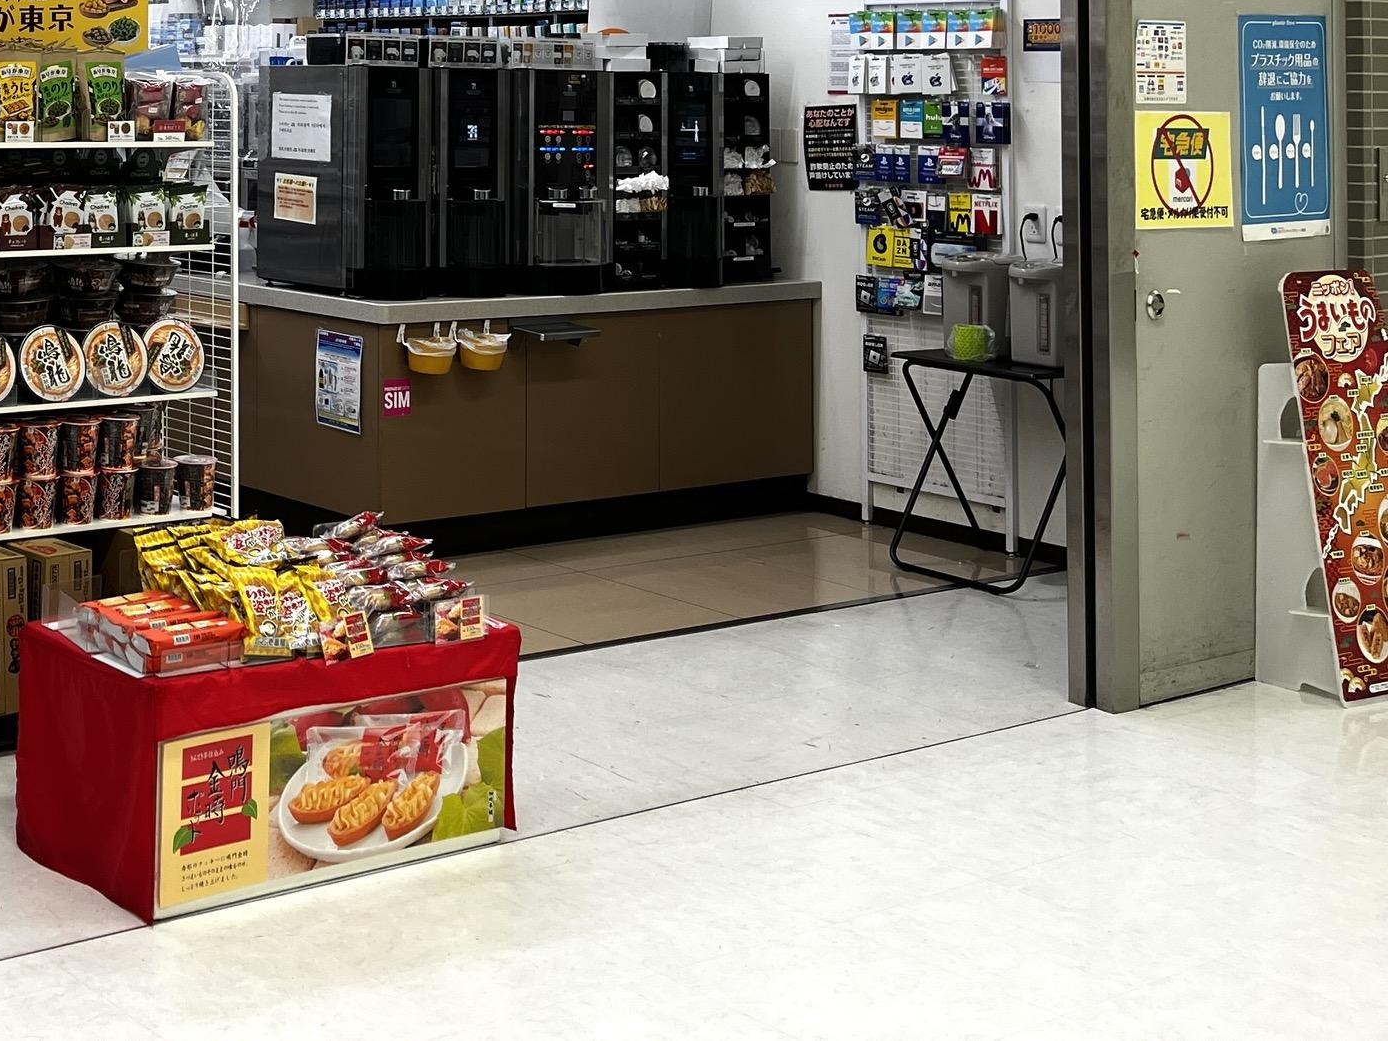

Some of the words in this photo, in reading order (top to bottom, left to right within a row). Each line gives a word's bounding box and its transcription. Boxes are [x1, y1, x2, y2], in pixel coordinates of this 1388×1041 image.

[806, 108, 854, 119] あなたのことが
[808, 118, 851, 128] 心配なんです
[809, 171, 853, 180] 声掛けしていま
[1297, 294, 1376, 342] うまいもの
[1321, 332, 1361, 358] フェア
[384, 391, 410, 409] SIM
